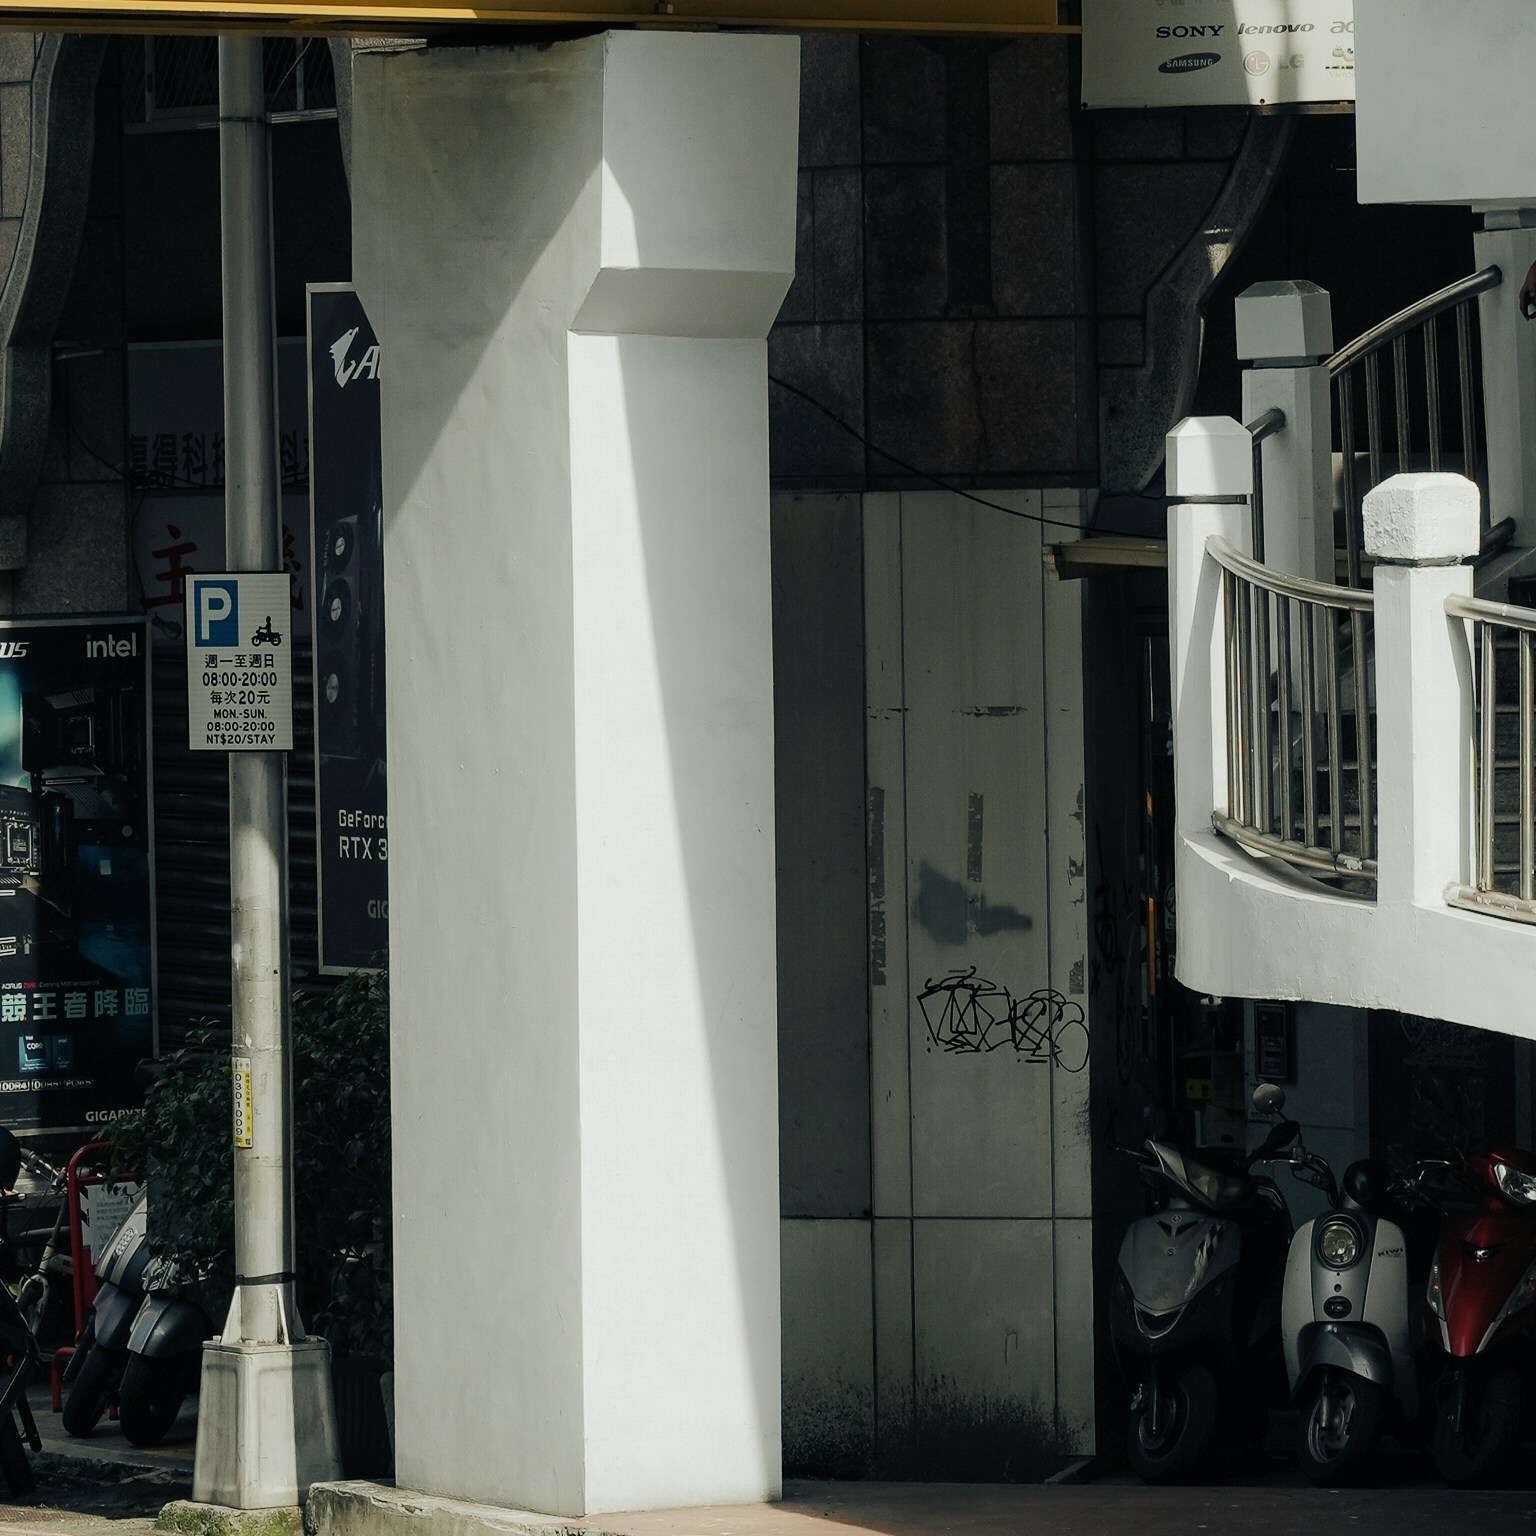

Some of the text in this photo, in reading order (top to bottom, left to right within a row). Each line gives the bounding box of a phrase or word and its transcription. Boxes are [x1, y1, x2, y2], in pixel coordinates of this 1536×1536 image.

[1156, 25, 1225, 39] SONY
[1237, 22, 1315, 35] lenovo
[1165, 53, 1305, 70] SAMSUNG LG
[200, 587, 232, 640] P
[86, 632, 138, 658] intel
[205, 654, 275, 668] 週一至週日
[202, 672, 278, 687] 08:00-20:00
[210, 690, 271, 705] 每次20元
[213, 708, 268, 719] MON.-SUN.
[207, 721, 275, 732] 08:00-20:00
[206, 733, 276, 746] NT$20/STAY
[338, 809, 388, 829] GeForc
[339, 835, 373, 860] RTX
